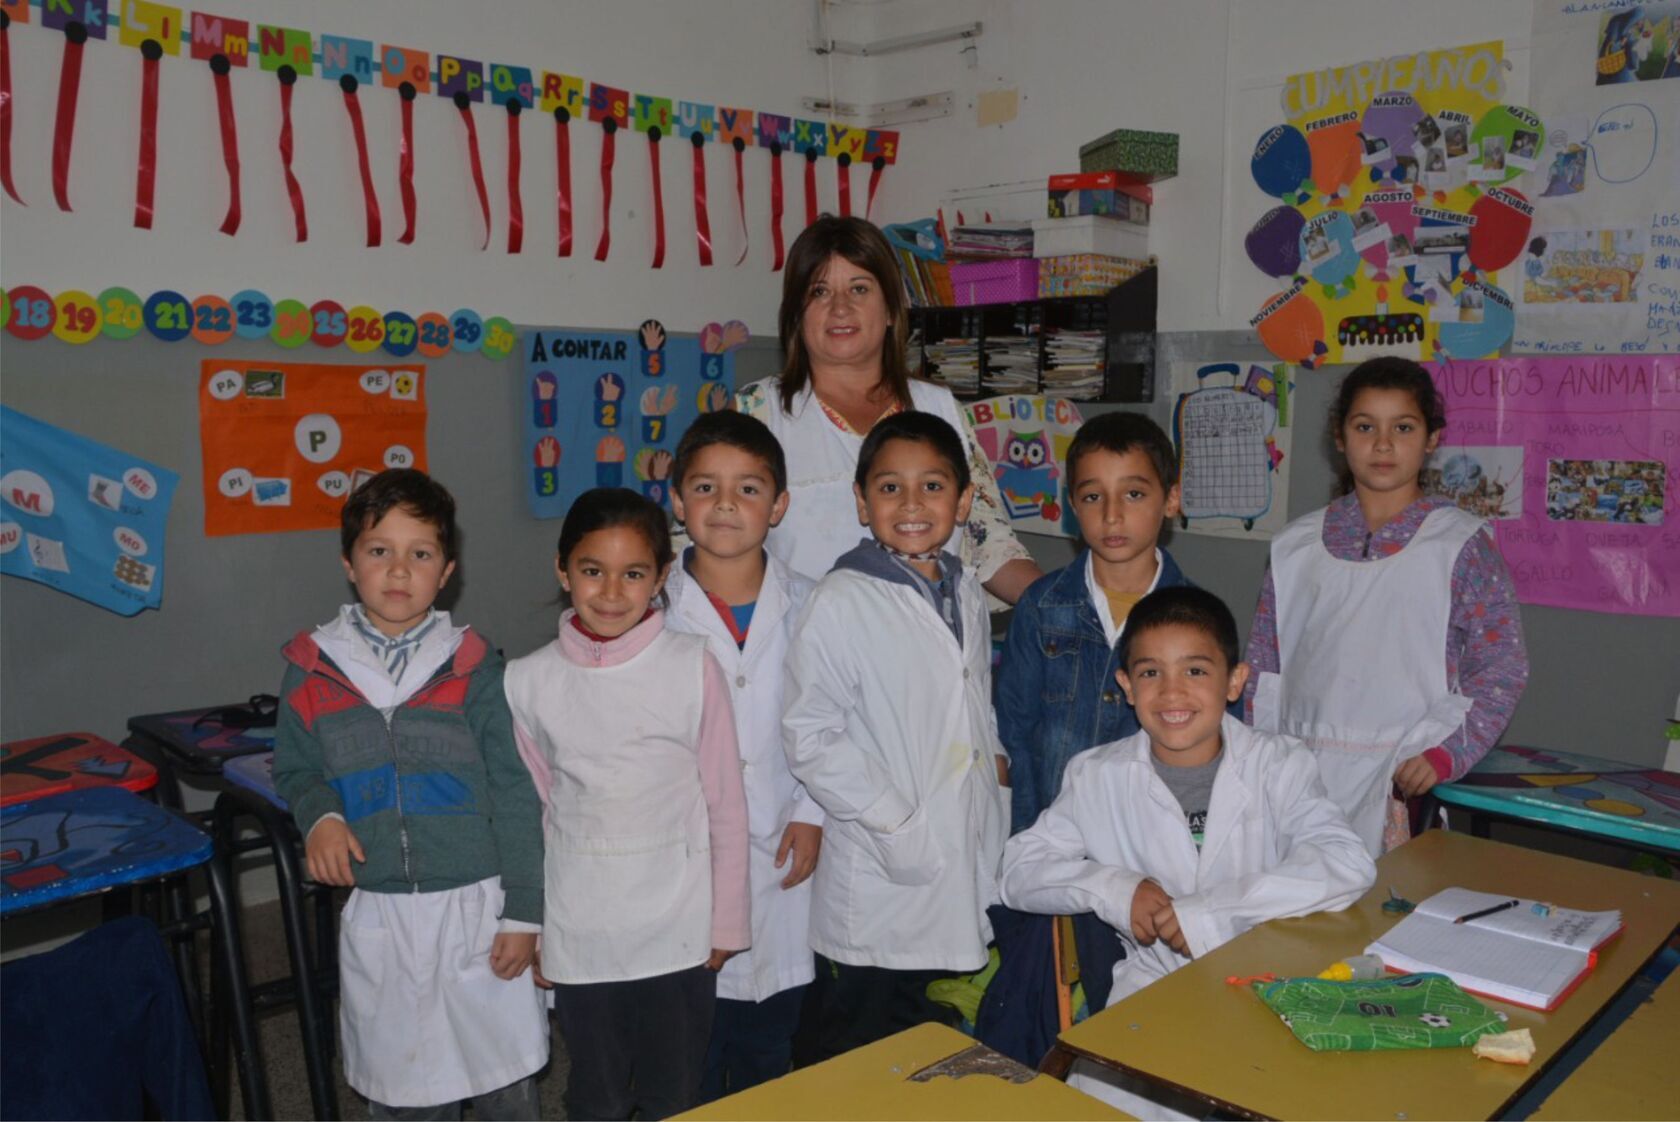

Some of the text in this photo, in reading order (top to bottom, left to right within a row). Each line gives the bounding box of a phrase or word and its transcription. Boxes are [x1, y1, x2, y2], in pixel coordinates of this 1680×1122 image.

[1373, 96, 1413, 107] MARZO
[1305, 111, 1358, 131] FEBRERO
[1438, 110, 1471, 125] ABRIL
[1507, 105, 1540, 128] MAYO
[1255, 127, 1283, 160] ENERO
[1364, 192, 1413, 203] AGOSTO
[1487, 187, 1535, 215] OCTUBRE
[1308, 211, 1338, 232] JULIO
[1412, 206, 1476, 226] SEPTIEMBRE
[1249, 284, 1302, 328] NOVIEMBRE
[14, 297, 51, 328] 18
[62, 302, 97, 333] 19
[107, 298, 142, 329] 20
[154, 301, 189, 329] 21
[196, 305, 231, 331] 22
[237, 300, 270, 328] 23
[315, 310, 346, 336] 25
[350, 317, 383, 342] 26
[386, 320, 414, 346] 27
[421, 322, 449, 348] 28
[454, 317, 482, 344] 29
[532, 332, 627, 362] A CONTAR
[648, 355, 661, 376] 5
[706, 358, 719, 376] 6
[216, 380, 236, 393] PA
[366, 375, 384, 387] PE
[542, 403, 552, 425] 1
[602, 404, 616, 427] 2
[650, 420, 662, 441] 7
[309, 430, 327, 453] P
[390, 453, 406, 464] PO
[128, 473, 151, 495] ME
[229, 477, 243, 490] PI
[325, 479, 342, 490] PU
[541, 472, 555, 494] 3
[12, 487, 41, 513] M
[119, 532, 140, 551] MO
